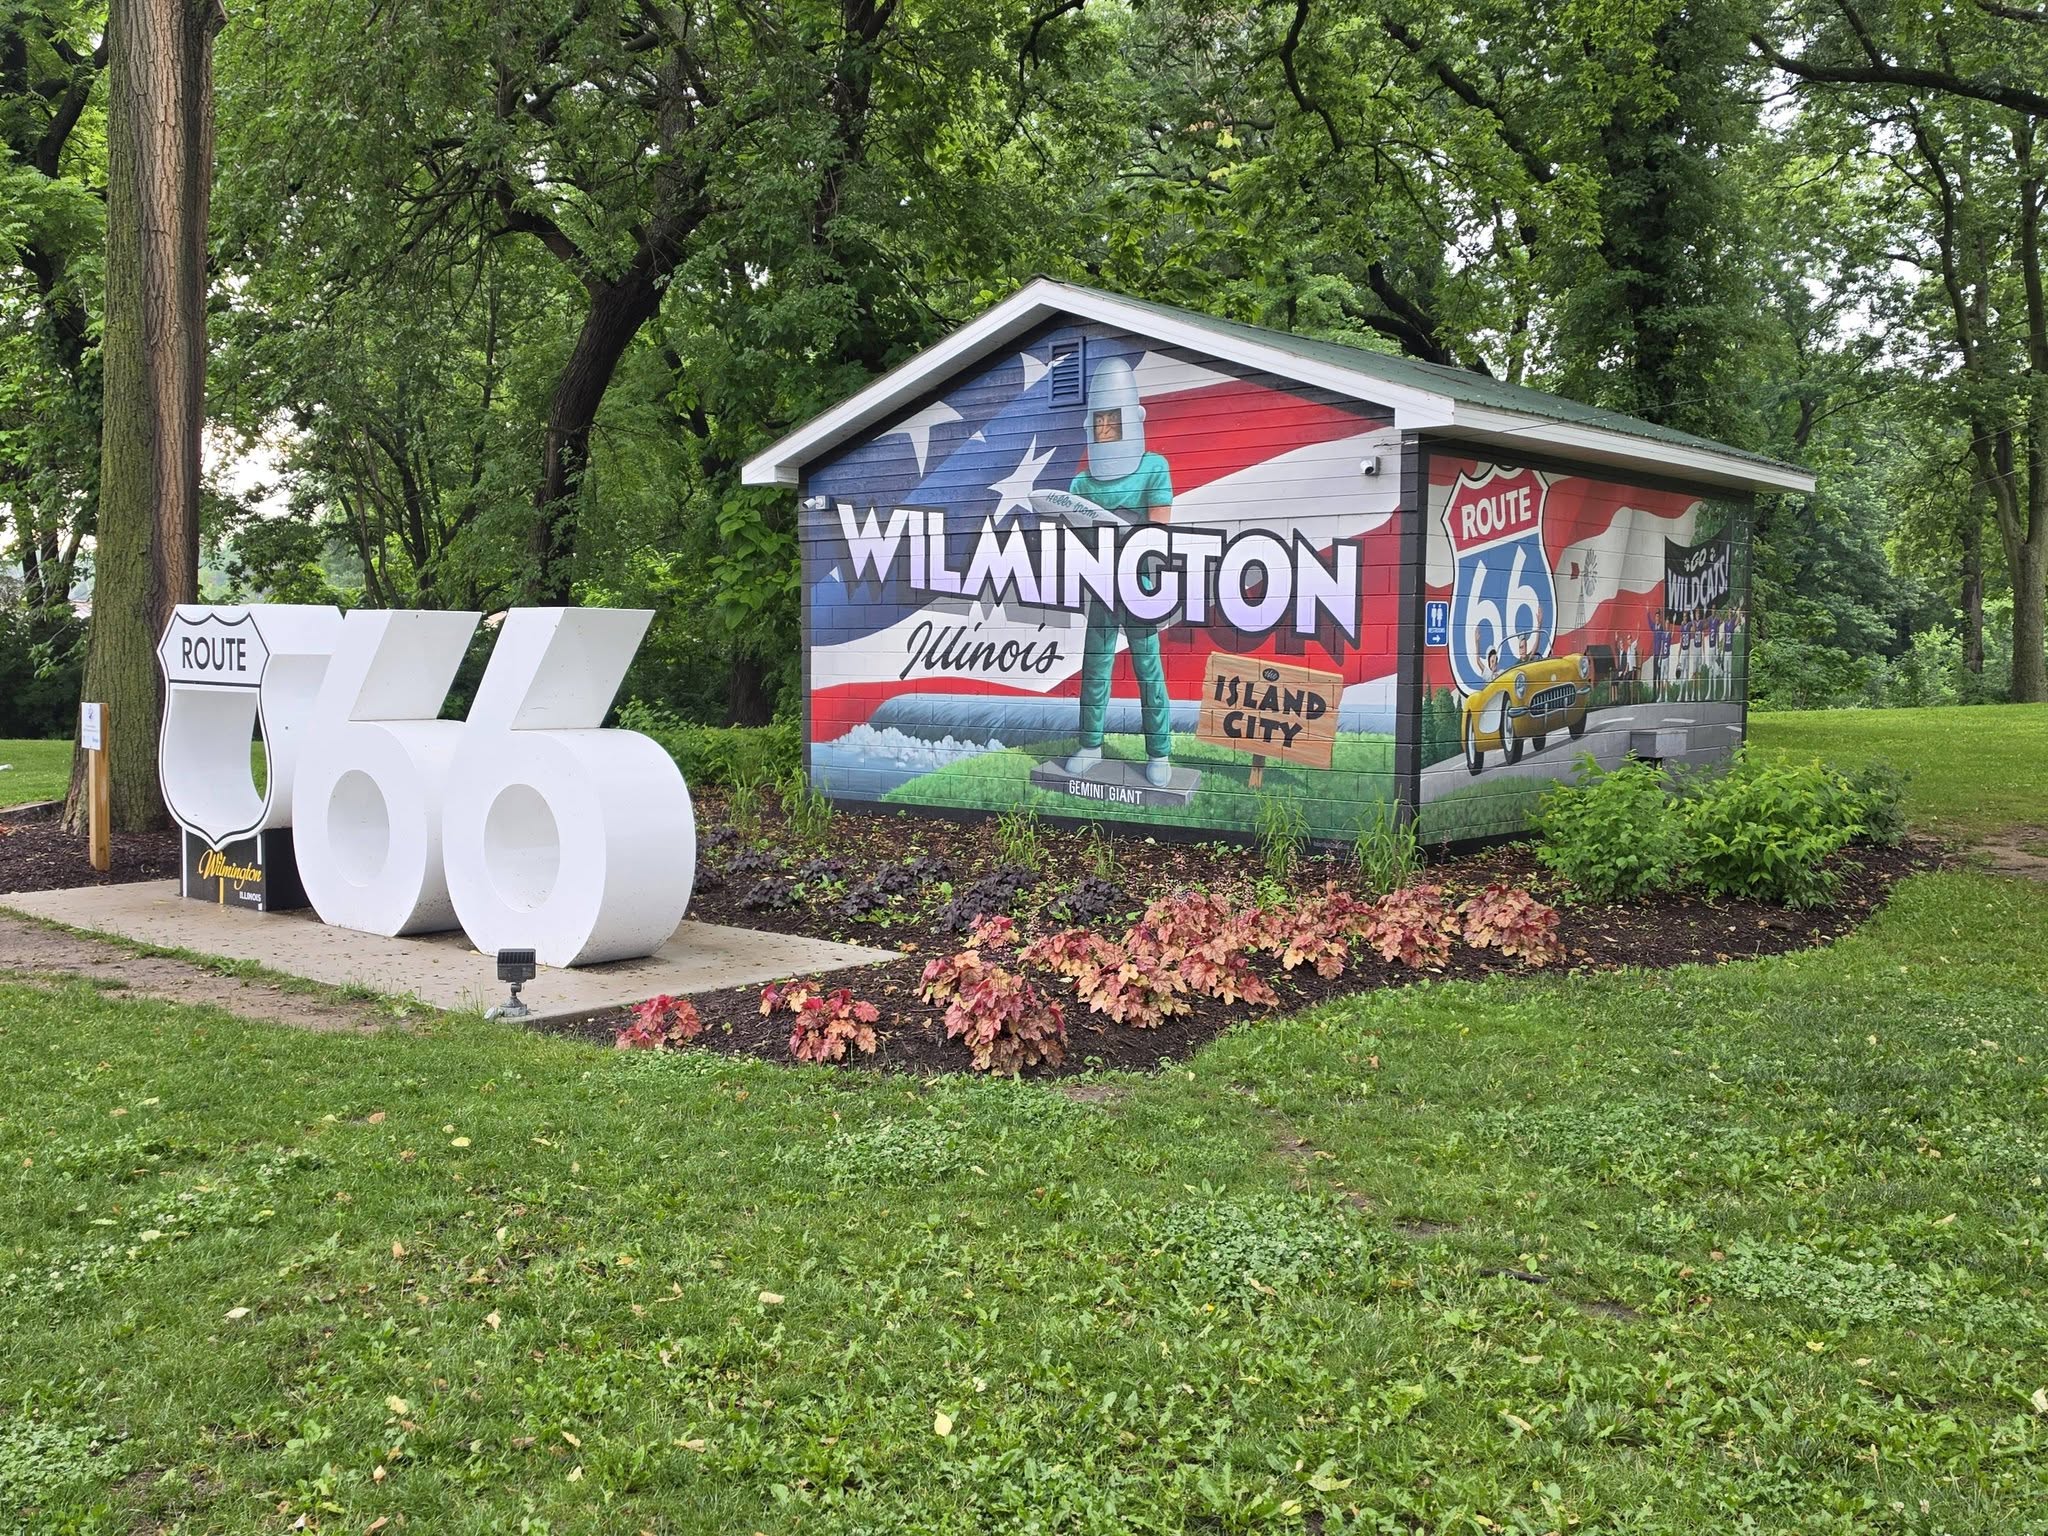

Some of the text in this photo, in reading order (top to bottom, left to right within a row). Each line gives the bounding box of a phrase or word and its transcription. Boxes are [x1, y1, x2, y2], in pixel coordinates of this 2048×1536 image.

[1045, 492, 1073, 508] Hello
[1462, 486, 1532, 540] ROUTE
[834, 502, 1360, 641] WILMINGTON
[1668, 544, 1730, 612] WILDCATS!
[1691, 548, 1707, 572] GO
[1465, 545, 1541, 681] 66
[181, 636, 247, 672] ROUTE
[899, 620, 1065, 681] Illinois
[1214, 674, 1327, 720] ISLAND
[1223, 710, 1303, 748] CITY
[292, 606, 696, 968] 66
[1069, 779, 1143, 805] GEMINI GIANT
[198, 849, 262, 890] Wilmington
[239, 891, 262, 902] ILLINOIS
